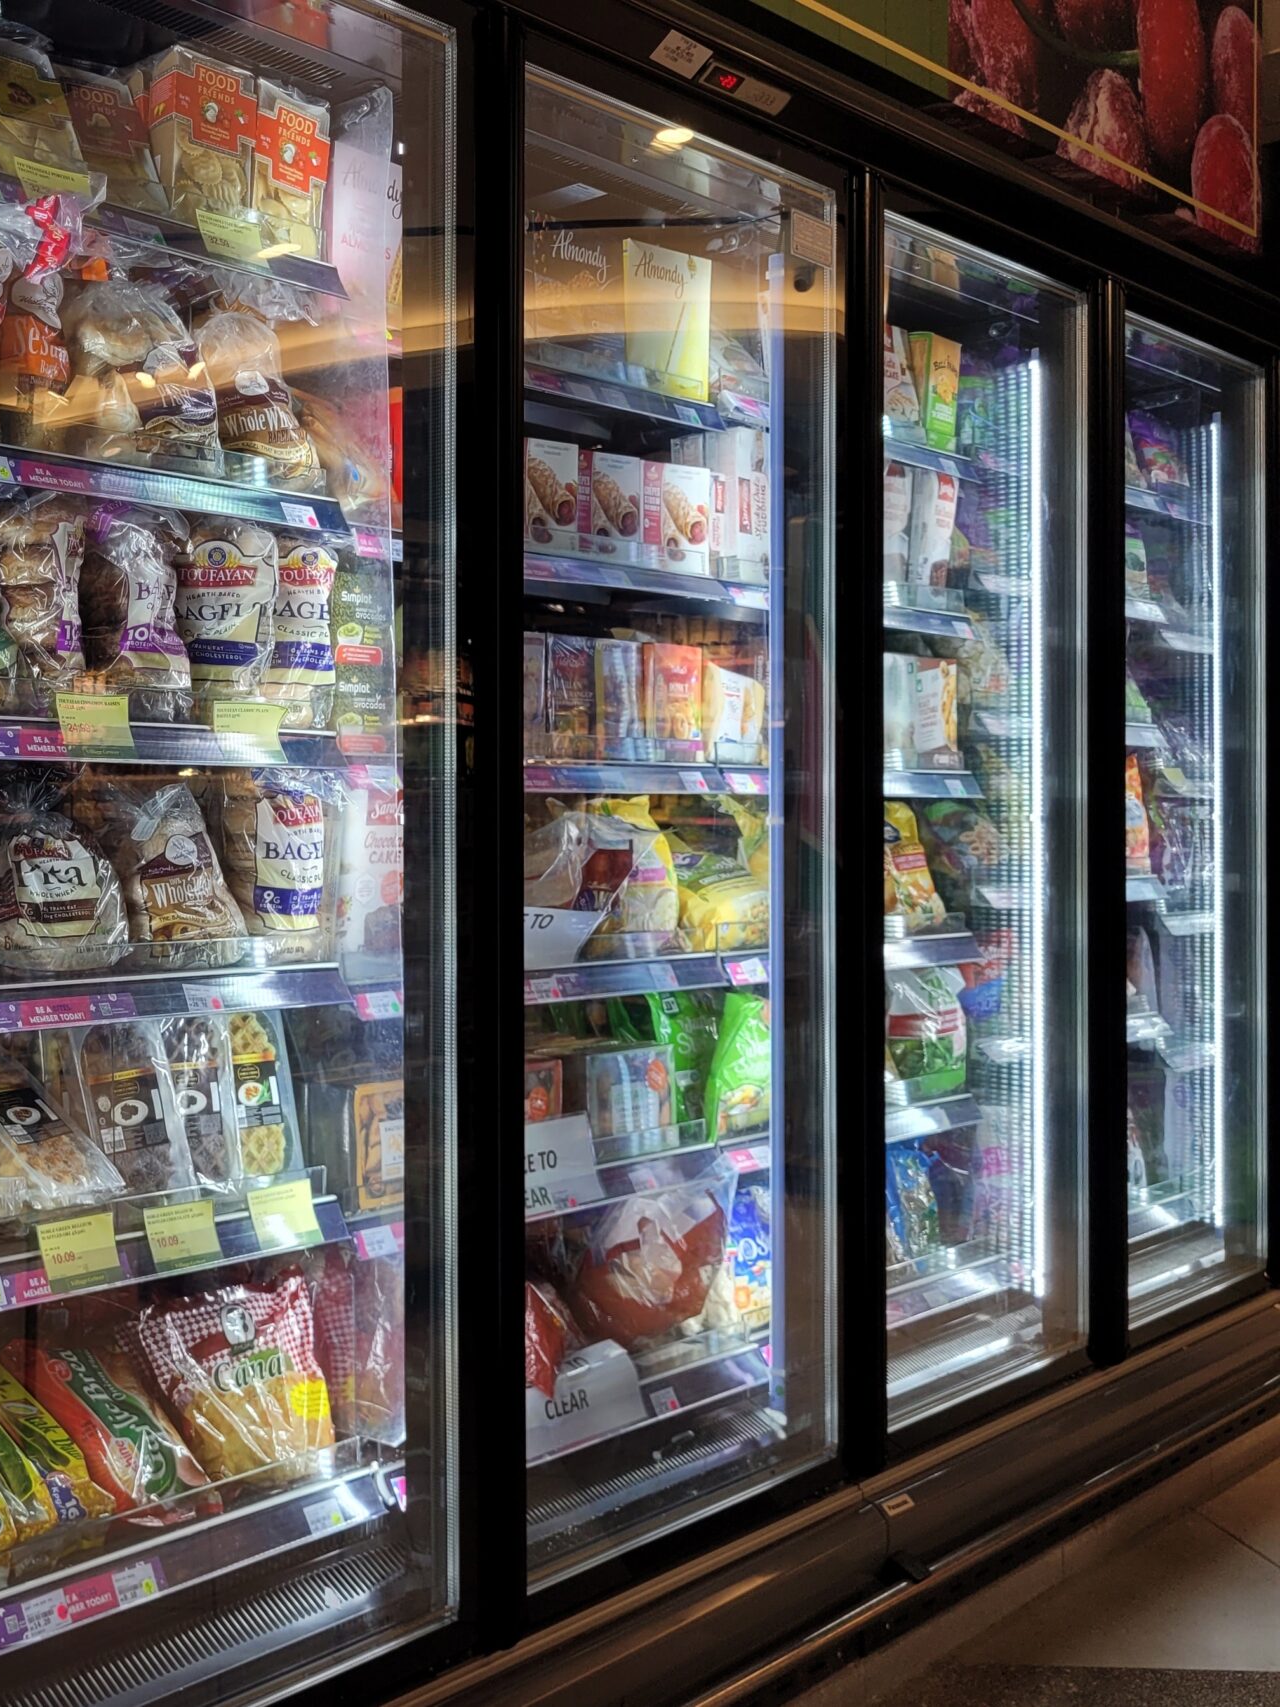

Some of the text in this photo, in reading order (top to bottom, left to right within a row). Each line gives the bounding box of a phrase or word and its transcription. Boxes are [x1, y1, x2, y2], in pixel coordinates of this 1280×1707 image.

[198, 67, 236, 93] FOOD
[279, 108, 314, 135] FOOD
[551, 230, 612, 283] Almondy
[633, 254, 690, 299] Almondy
[223, 411, 266, 438] Whole
[28, 475, 84, 489] MEMBER TODAY!
[178, 566, 255, 583] TOUFAYAN
[186, 592, 216, 601] HEARTH
[341, 590, 373, 604] Simplot
[277, 624, 317, 638] CLASSIC
[195, 651, 243, 661] CHOLESTEROL
[339, 680, 370, 694] Simplot
[354, 701, 386, 710] avocados
[27, 744, 57, 754] MEMBER
[530, 913, 553, 929] TO
[35, 1005, 45, 1014] BE
[29, 1011, 85, 1024] MEMBER TODAY!
[538, 1151, 557, 1168] TO
[52, 1251, 75, 1264] 10.09
[29, 1278, 38, 1287] BE
[544, 1388, 590, 1421] CLEAR
